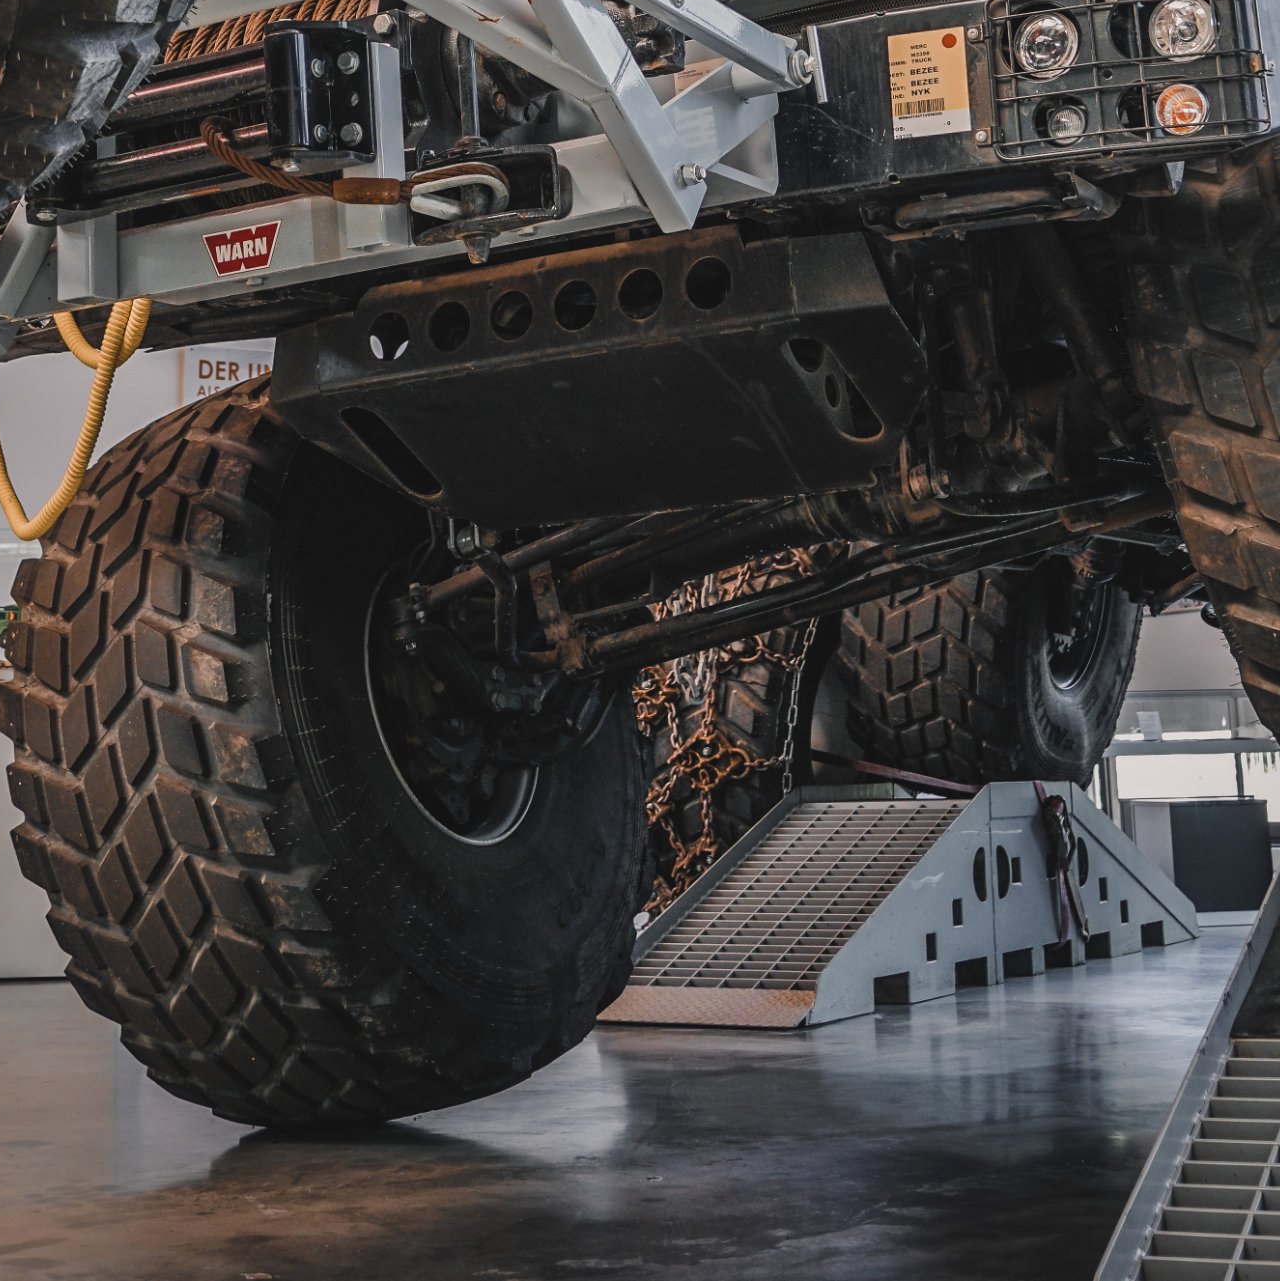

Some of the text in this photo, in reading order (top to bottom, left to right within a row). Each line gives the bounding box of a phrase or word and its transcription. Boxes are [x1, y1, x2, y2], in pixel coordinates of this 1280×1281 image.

[910, 66, 939, 76] BEZEE
[911, 78, 939, 87] BEZEE
[911, 88, 931, 97] NYK
[215, 236, 269, 263] WARN
[198, 359, 240, 382] DER
